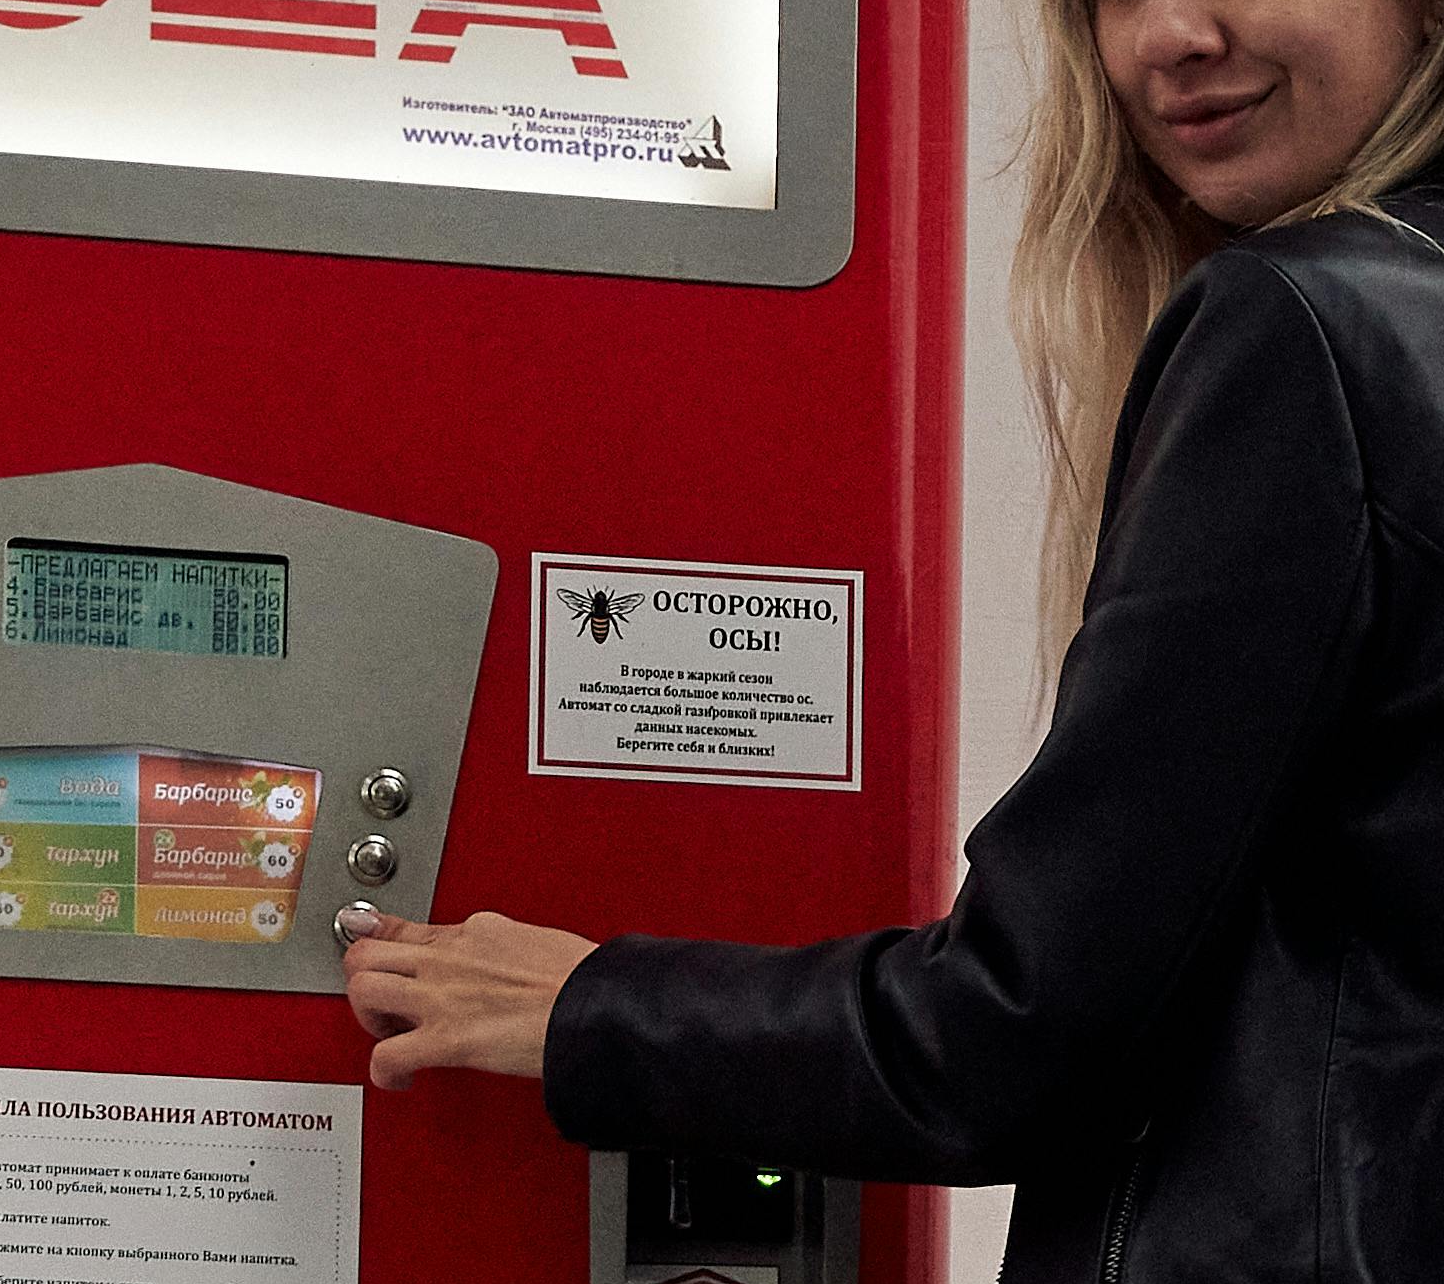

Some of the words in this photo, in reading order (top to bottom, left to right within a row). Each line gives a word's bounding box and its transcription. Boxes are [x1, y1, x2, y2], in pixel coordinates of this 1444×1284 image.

[402, 96, 499, 116] Изготовитель:
[526, 119, 576, 137] Москва
[580, 123, 613, 141] (495)
[616, 126, 680, 145] 234-01-95
[402, 126, 674, 163] www.avtomatpro.ru
[652, 589, 839, 626] ОСТОРОЖНО,
[709, 627, 781, 652] ОСЫ!
[620, 664, 629, 677] В
[631, 667, 674, 682] городе
[677, 670, 684, 679] в
[686, 668, 736, 684] жаркий
[738, 673, 773, 685] сезон
[579, 682, 661, 698] наблюдается
[663, 685, 719, 700] большое
[721, 690, 794, 704] количество
[796, 694, 814, 705] ос.
[558, 698, 612, 713] Автомат
[613, 703, 627, 713] со
[630, 702, 683, 718] сладкой
[685, 705, 757, 722] газировкой
[759, 710, 834, 725] привлекает
[634, 722, 683, 736] данных
[685, 724, 758, 738] насекомых.
[616, 737, 675, 753] Берегите
[676, 739, 705, 754] себя
[708, 744, 716, 754] и
[718, 742, 775, 758] близких!
[59, 776, 121, 797] Вода
[153, 782, 254, 807] Барбарис
[275, 798, 295, 810] 50
[153, 846, 254, 869] Барбарис
[267, 855, 288, 867] 60
[154, 906, 247, 925] Лимонад
[257, 914, 278, 926] 50
[37, 1101, 196, 1125] ПОЛЬЗОВАНИЯ
[200, 1109, 333, 1132] АВТОМАТОМ
[45, 1165, 120, 1178] принимает
[123, 1168, 132, 1178] к
[134, 1170, 181, 1181] оплате
[183, 1168, 250, 1183] банкноты
[6, 1177, 26, 1192] 50,
[29, 1178, 53, 1191] 100
[55, 1181, 108, 1195] рублей,
[110, 1185, 162, 1197] монеты
[166, 1185, 176, 1199] 1,
[180, 1185, 191, 1199] 2,
[193, 1186, 206, 1201] 5,
[208, 1187, 225, 1199] 10
[227, 1188, 278, 1203] рублей.
[51, 1214, 111, 1227] напиток.
[47, 1246, 63, 1256] на
[66, 1246, 115, 1260] кнопку
[118, 1247, 200, 1262] выбранного
[202, 1250, 237, 1263] Вами
[240, 1254, 299, 1267] напитка.
